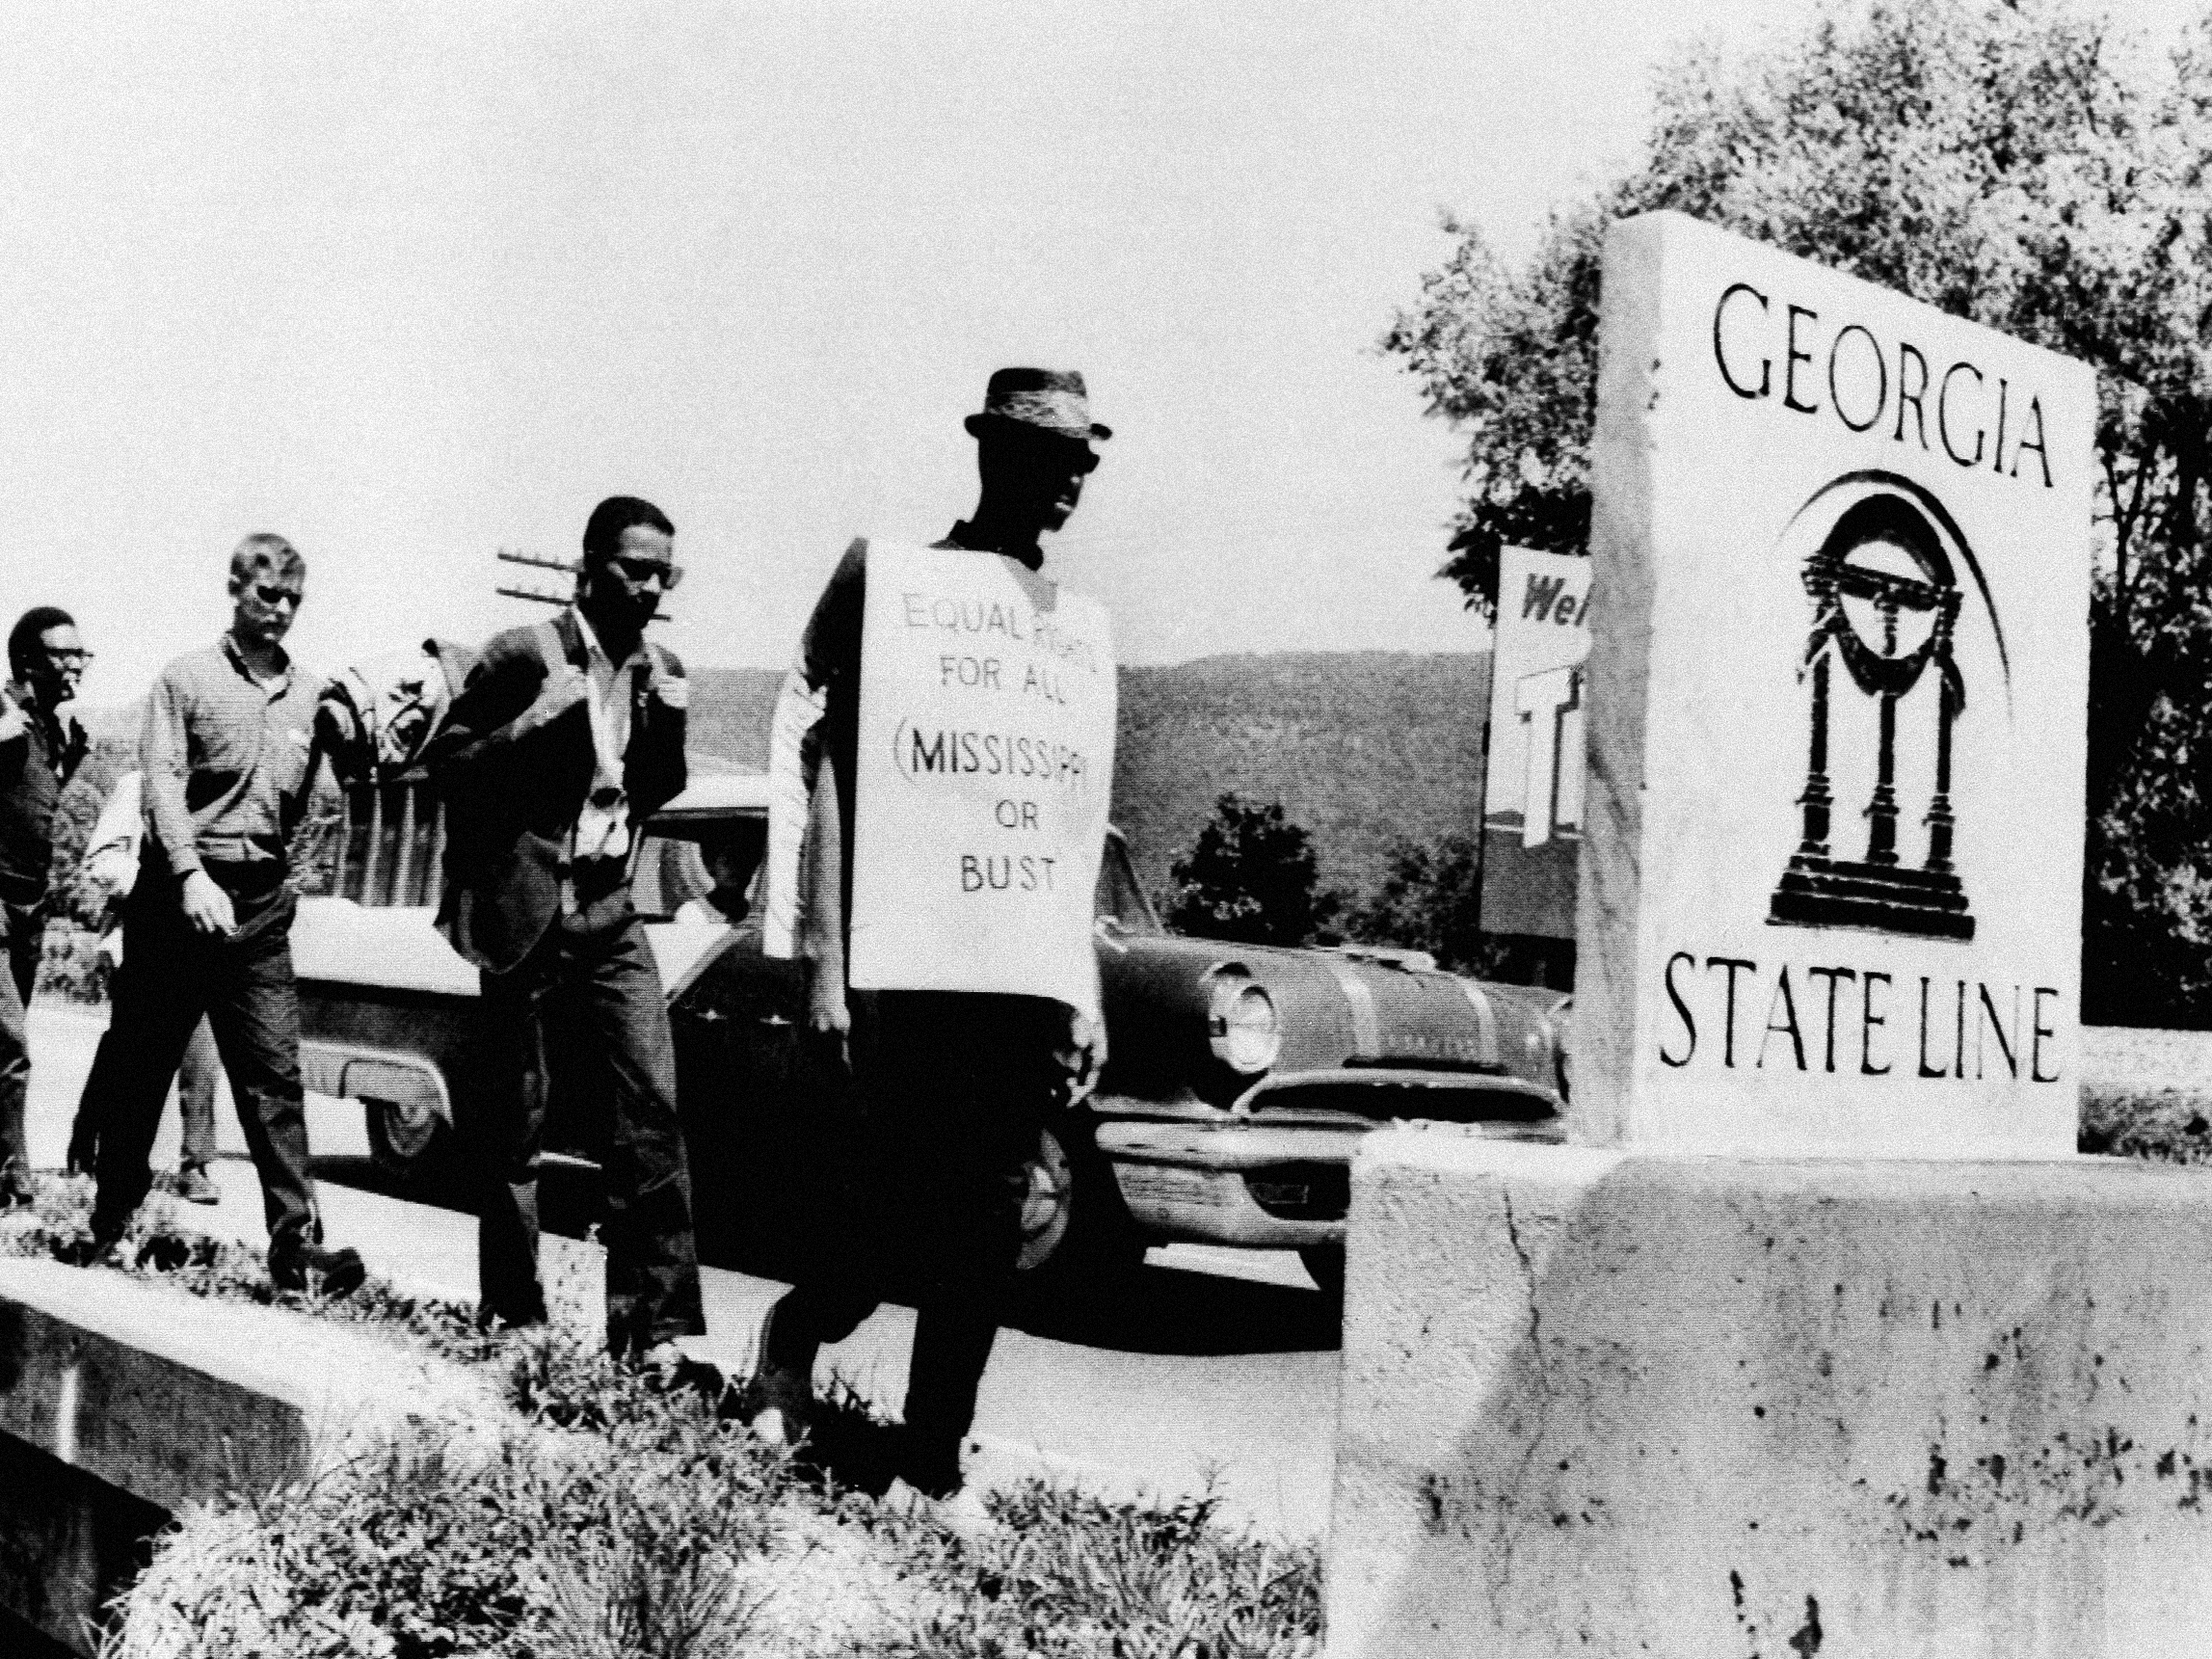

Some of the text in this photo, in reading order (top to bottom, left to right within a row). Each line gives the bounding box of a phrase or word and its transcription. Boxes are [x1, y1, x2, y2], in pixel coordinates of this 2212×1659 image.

[1714, 282, 2054, 489] GEORGIA
[901, 592, 1025, 641] EQUAL
[940, 656, 1067, 706] FOR ALL
[995, 798, 1039, 830] OR
[961, 854, 1056, 893] BUST
[1659, 950, 2060, 1083] STATE LINE
